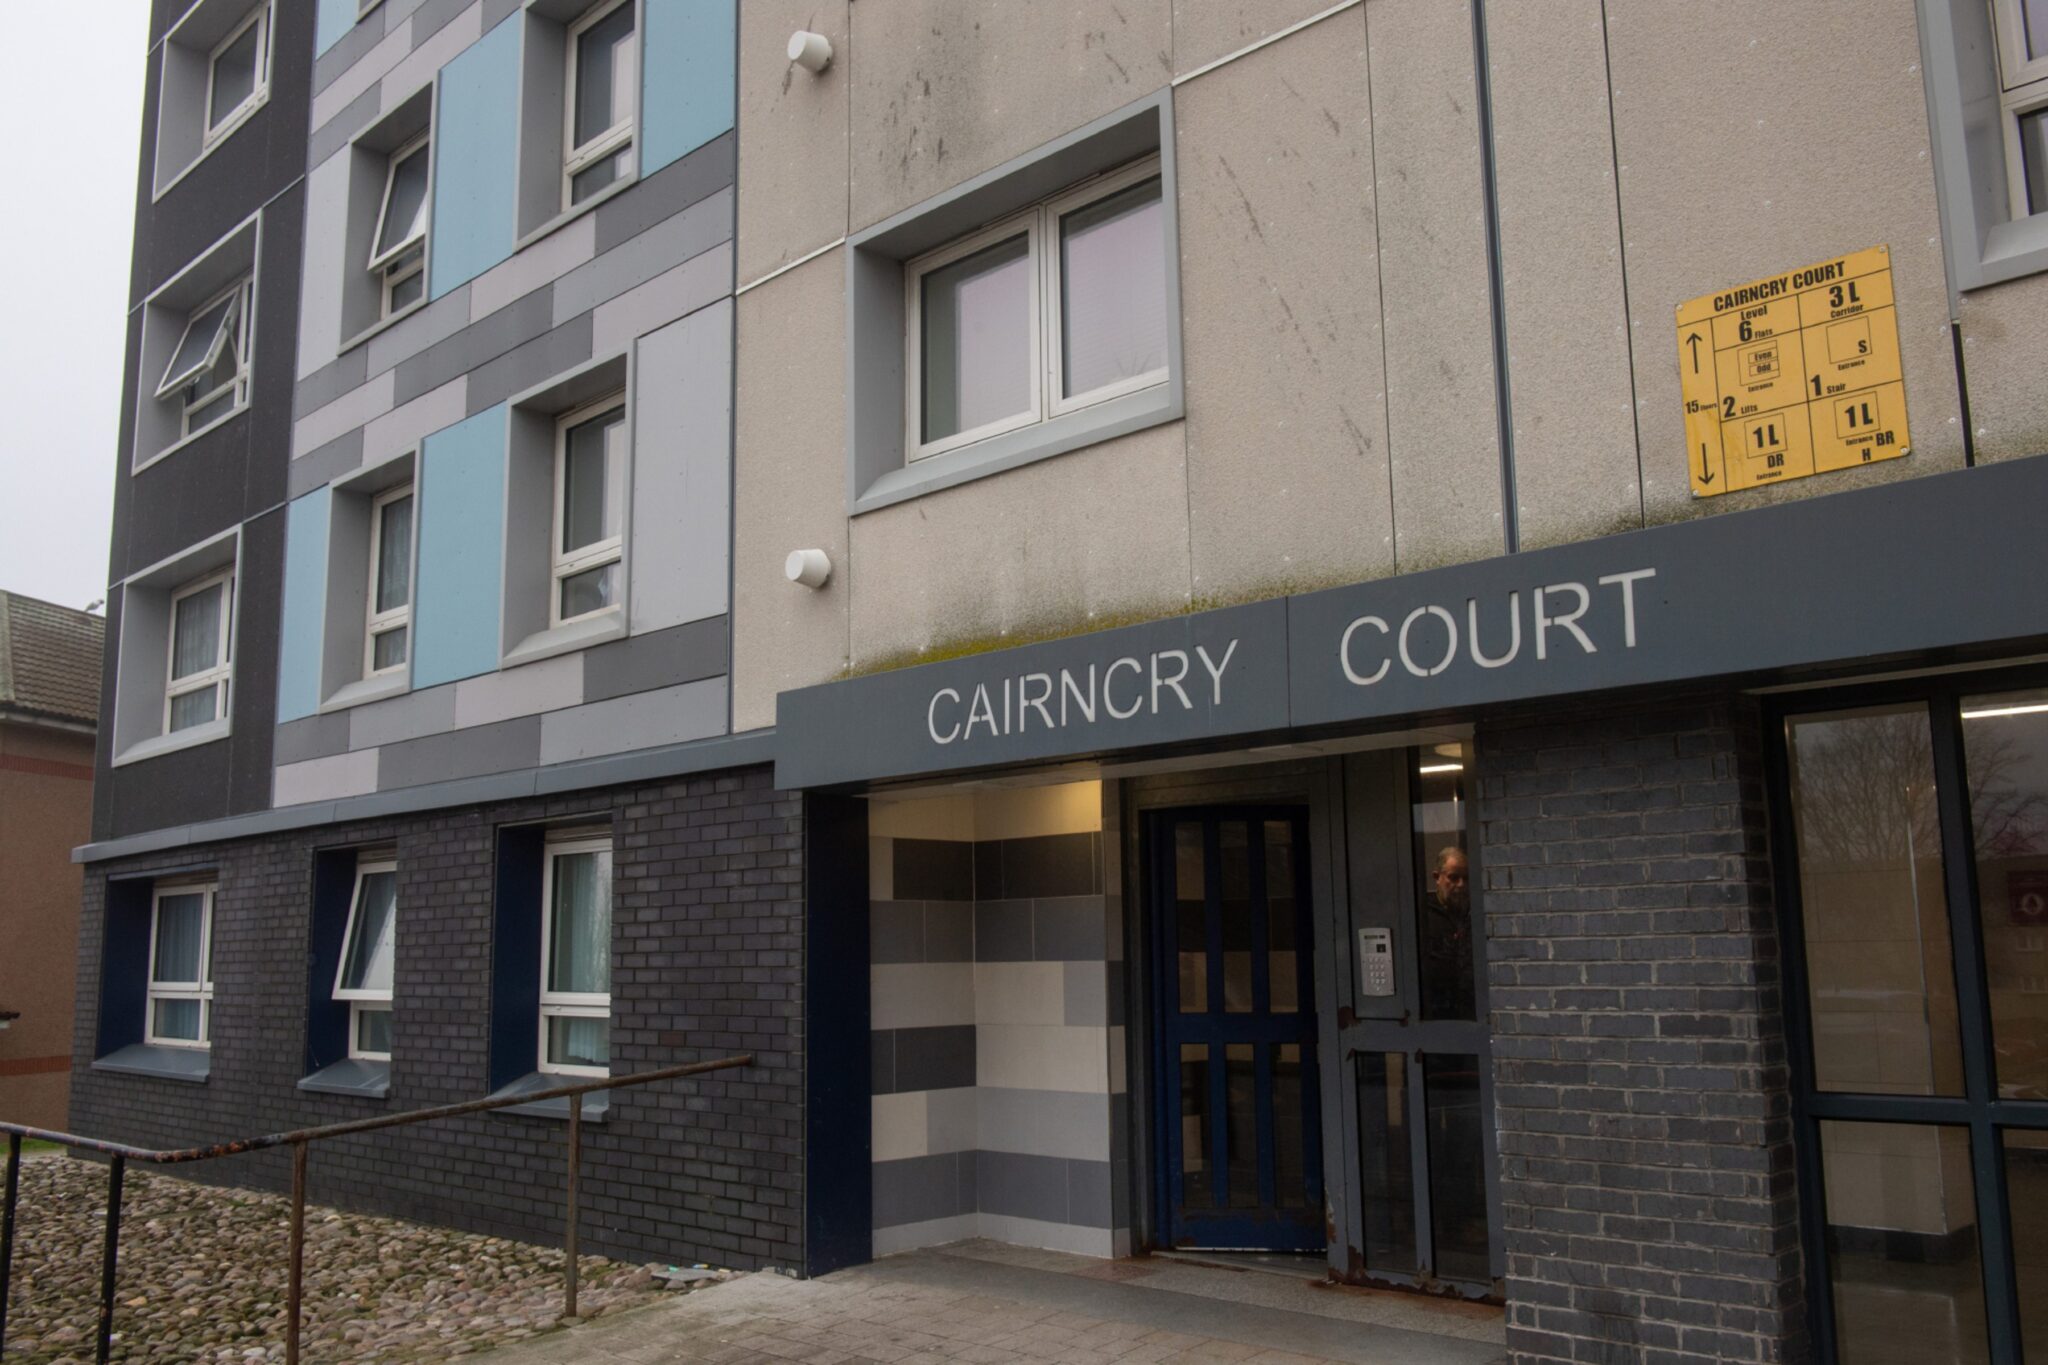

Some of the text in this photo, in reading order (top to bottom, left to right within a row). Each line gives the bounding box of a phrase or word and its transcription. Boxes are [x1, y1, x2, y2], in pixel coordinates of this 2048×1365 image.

[1714, 261, 1845, 312] CAIRNCRY COURT
[1829, 281, 1860, 308] 3 L
[1741, 305, 1768, 320] Level
[1830, 304, 1864, 318] Corridor
[1739, 320, 1773, 342] 6 Flats
[1858, 340, 1867, 353] S
[1754, 351, 1772, 361] Even
[1757, 364, 1771, 373] Odd
[1838, 360, 1865, 370] Entrance
[1748, 382, 1774, 392] Entrance
[1810, 374, 1846, 396] 1 Stair
[1686, 400, 1699, 414] 15
[1723, 396, 1758, 418] 2 Lifts
[1844, 402, 1873, 428] 1 L
[1752, 424, 1779, 448] 1 L
[1846, 430, 1894, 446] Entrance BR
[1767, 453, 1784, 468] DR
[1862, 448, 1871, 461] H
[1756, 470, 1782, 480] Entrance
[926, 567, 1657, 746] CAIRNCRY COURT
